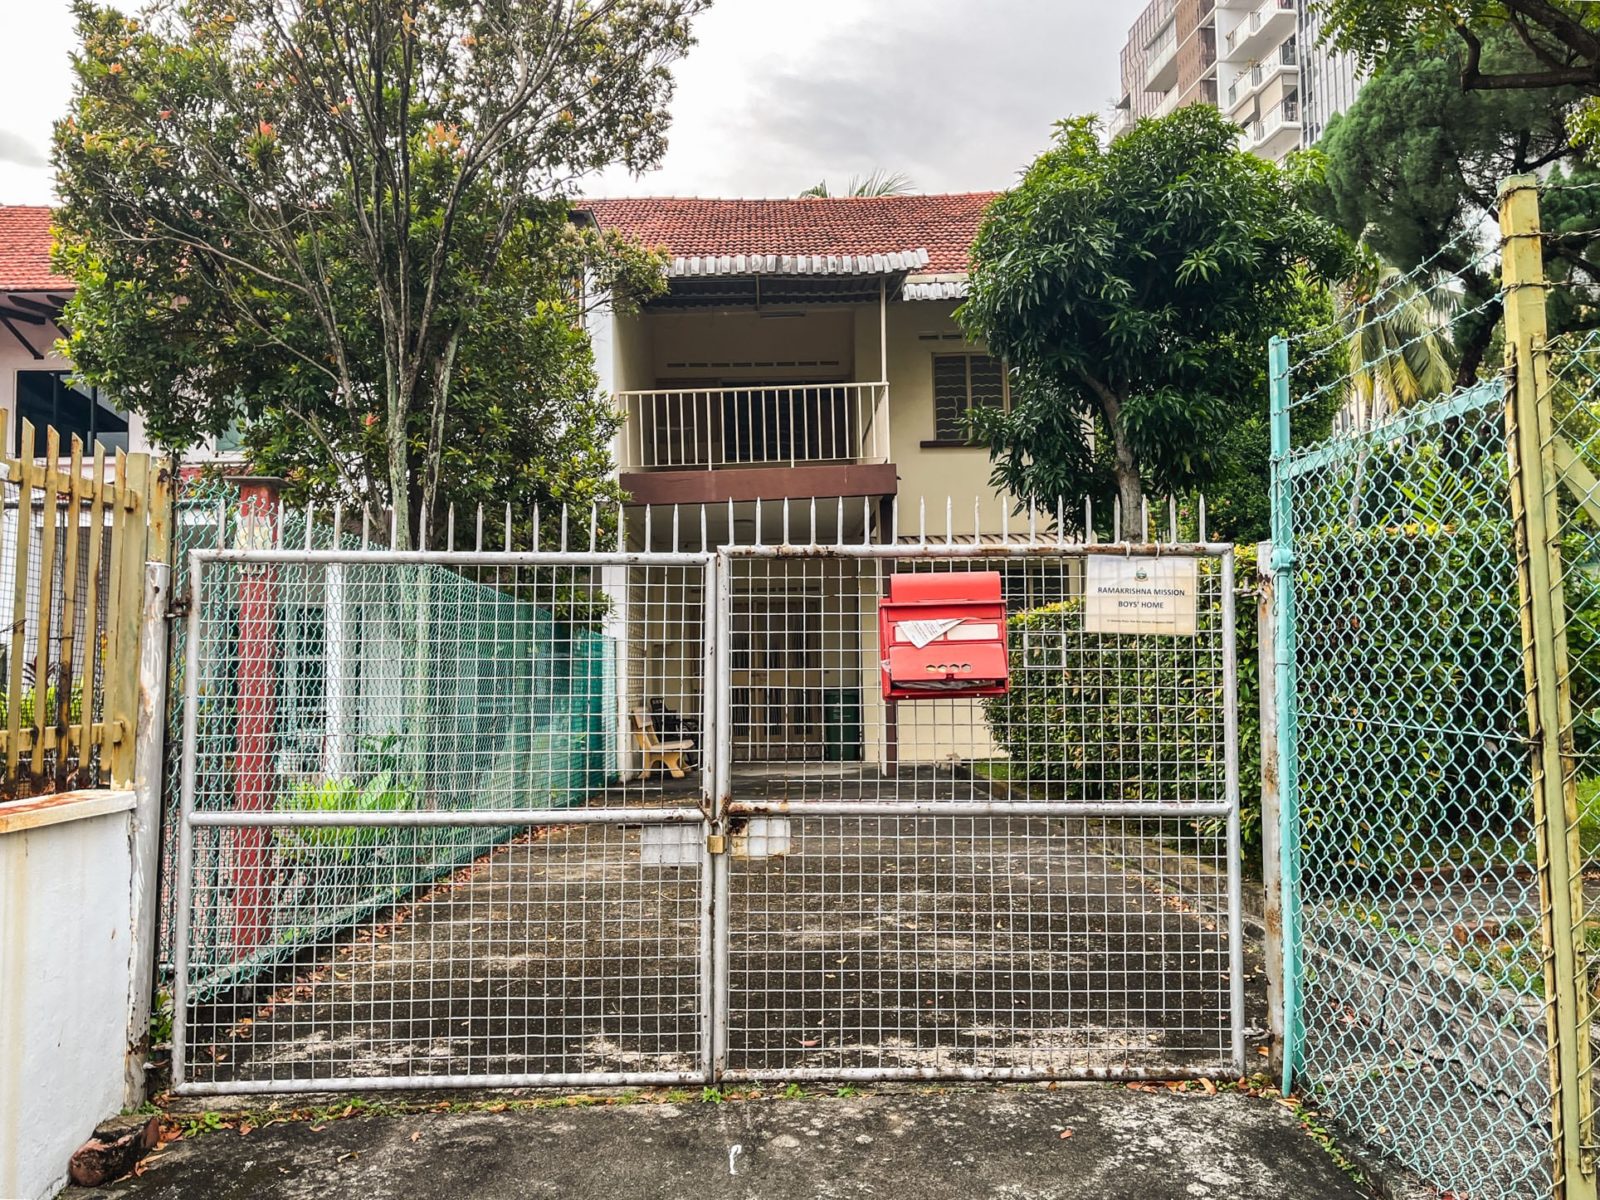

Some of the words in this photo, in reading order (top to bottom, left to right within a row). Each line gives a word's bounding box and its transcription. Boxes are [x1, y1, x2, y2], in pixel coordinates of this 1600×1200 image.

[1097, 586, 1152, 595] RAMAKRISHNA
[1153, 588, 1185, 596] MISSION
[1118, 600, 1140, 608] BOYS'
[1141, 601, 1164, 609] HOME
